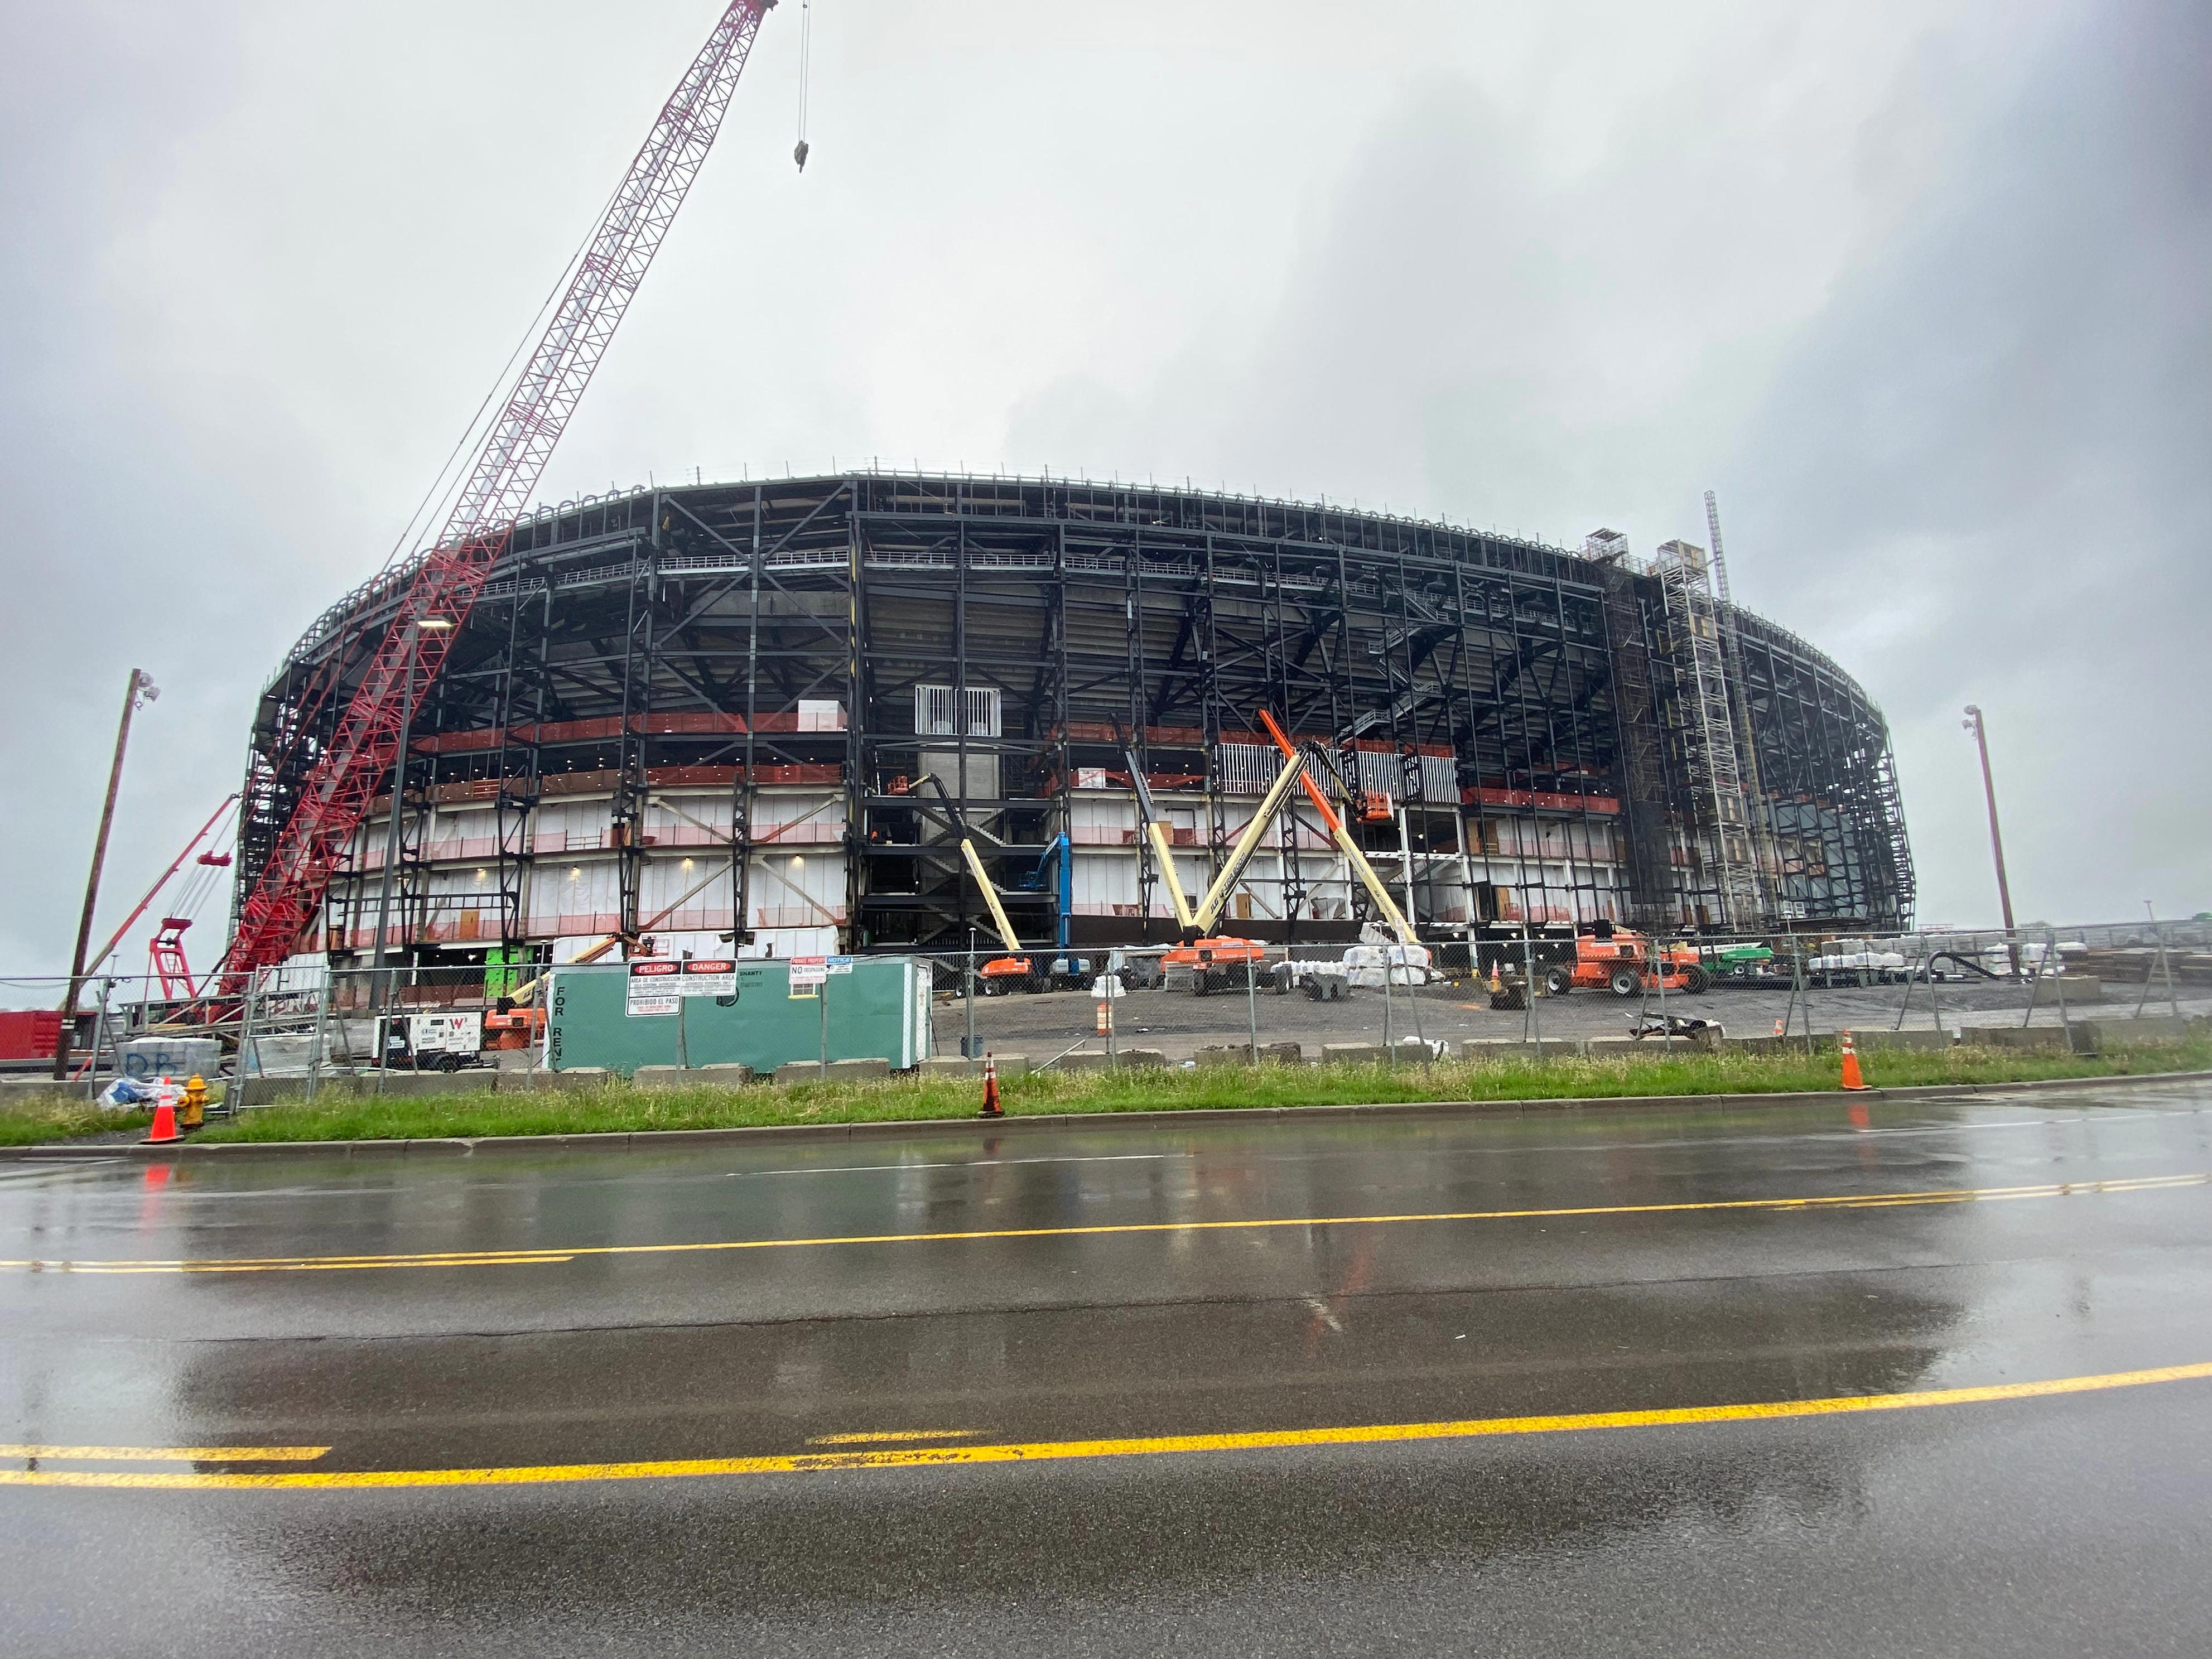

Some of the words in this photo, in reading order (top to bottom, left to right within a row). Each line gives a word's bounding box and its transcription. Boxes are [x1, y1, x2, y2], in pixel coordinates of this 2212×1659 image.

[1209, 897, 1219, 914] JLG
[639, 964, 673, 973] PELIGRO
[555, 987, 565, 1016] FOR
